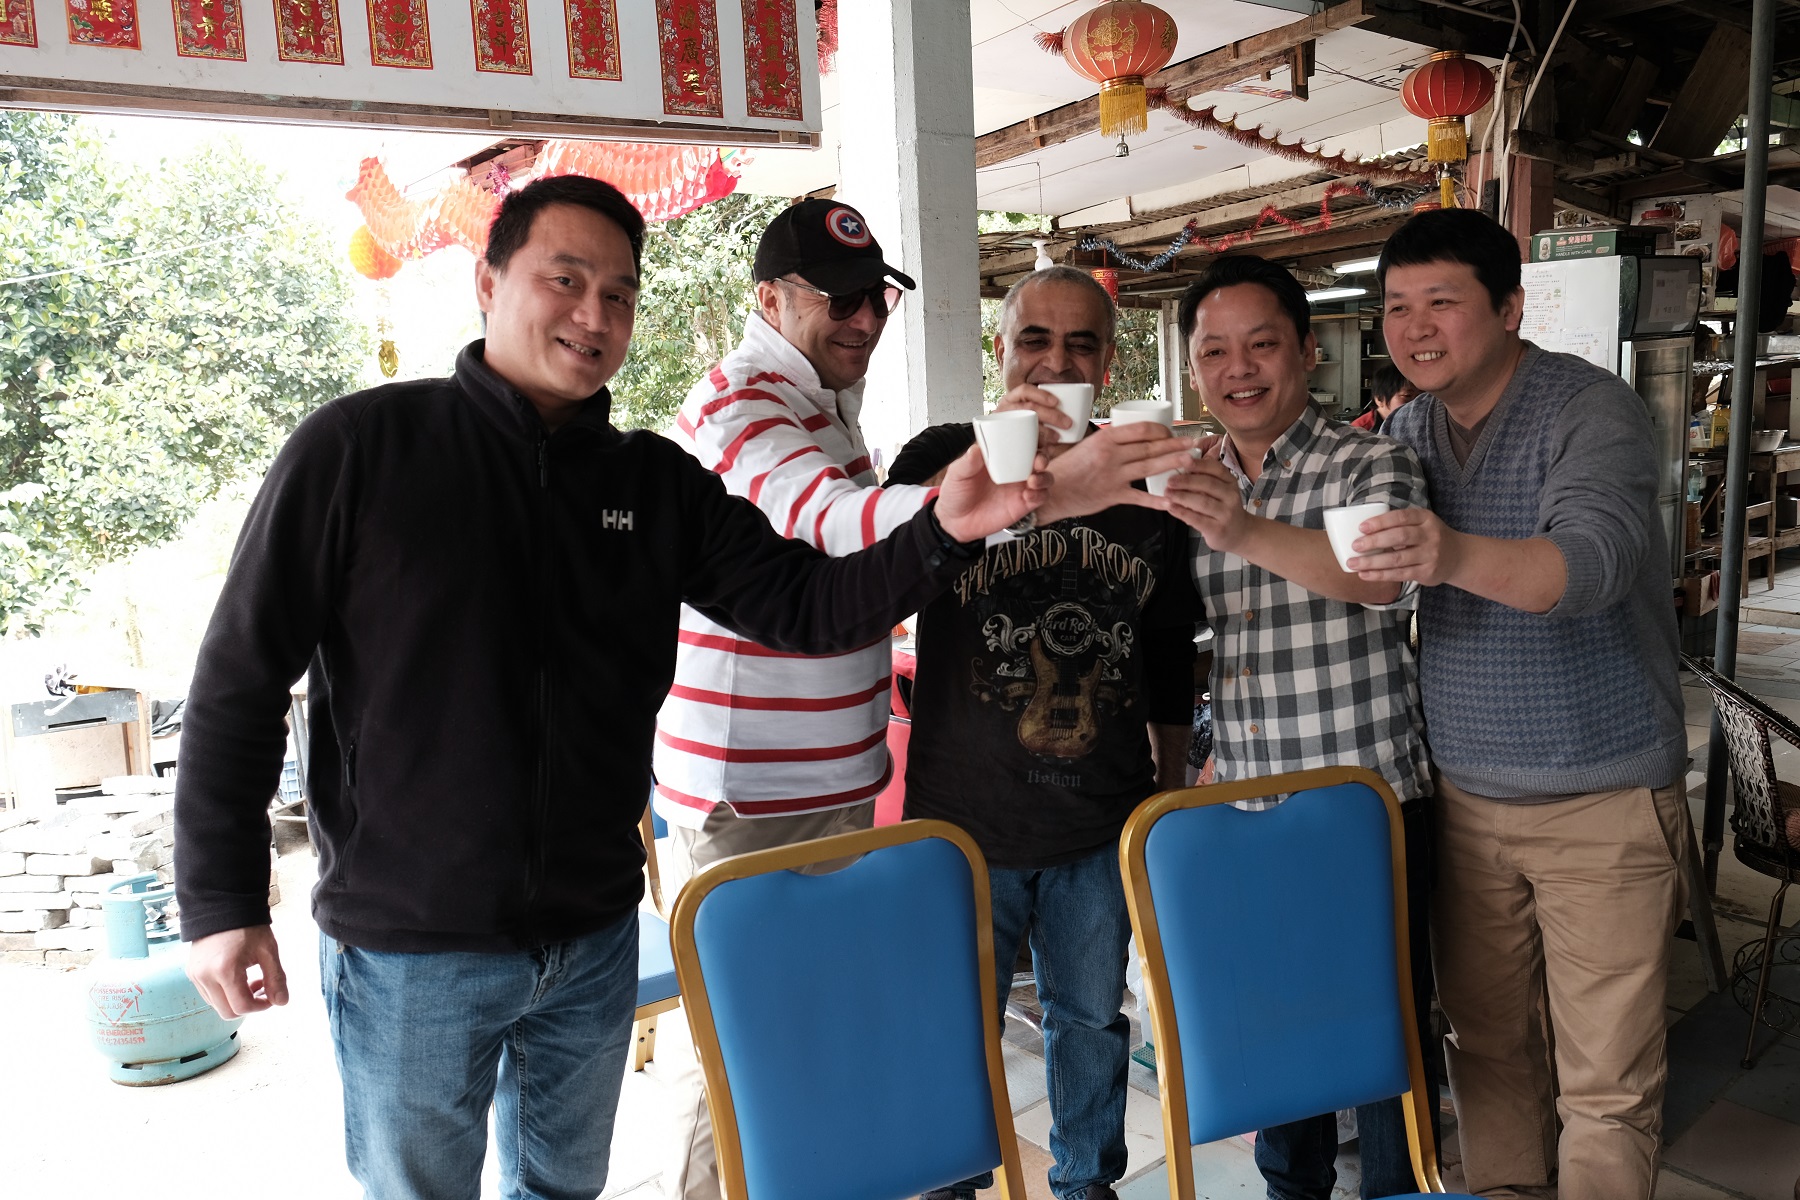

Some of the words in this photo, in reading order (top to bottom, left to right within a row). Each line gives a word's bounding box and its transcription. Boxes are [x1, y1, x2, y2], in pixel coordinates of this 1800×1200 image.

[491, 0, 511, 57] 吉祥
[602, 509, 633, 531] HH
[1035, 614, 1069, 631] Hard
[1069, 616, 1099, 635] Rock
[106, 1027, 144, 1036] EMERGENCY
